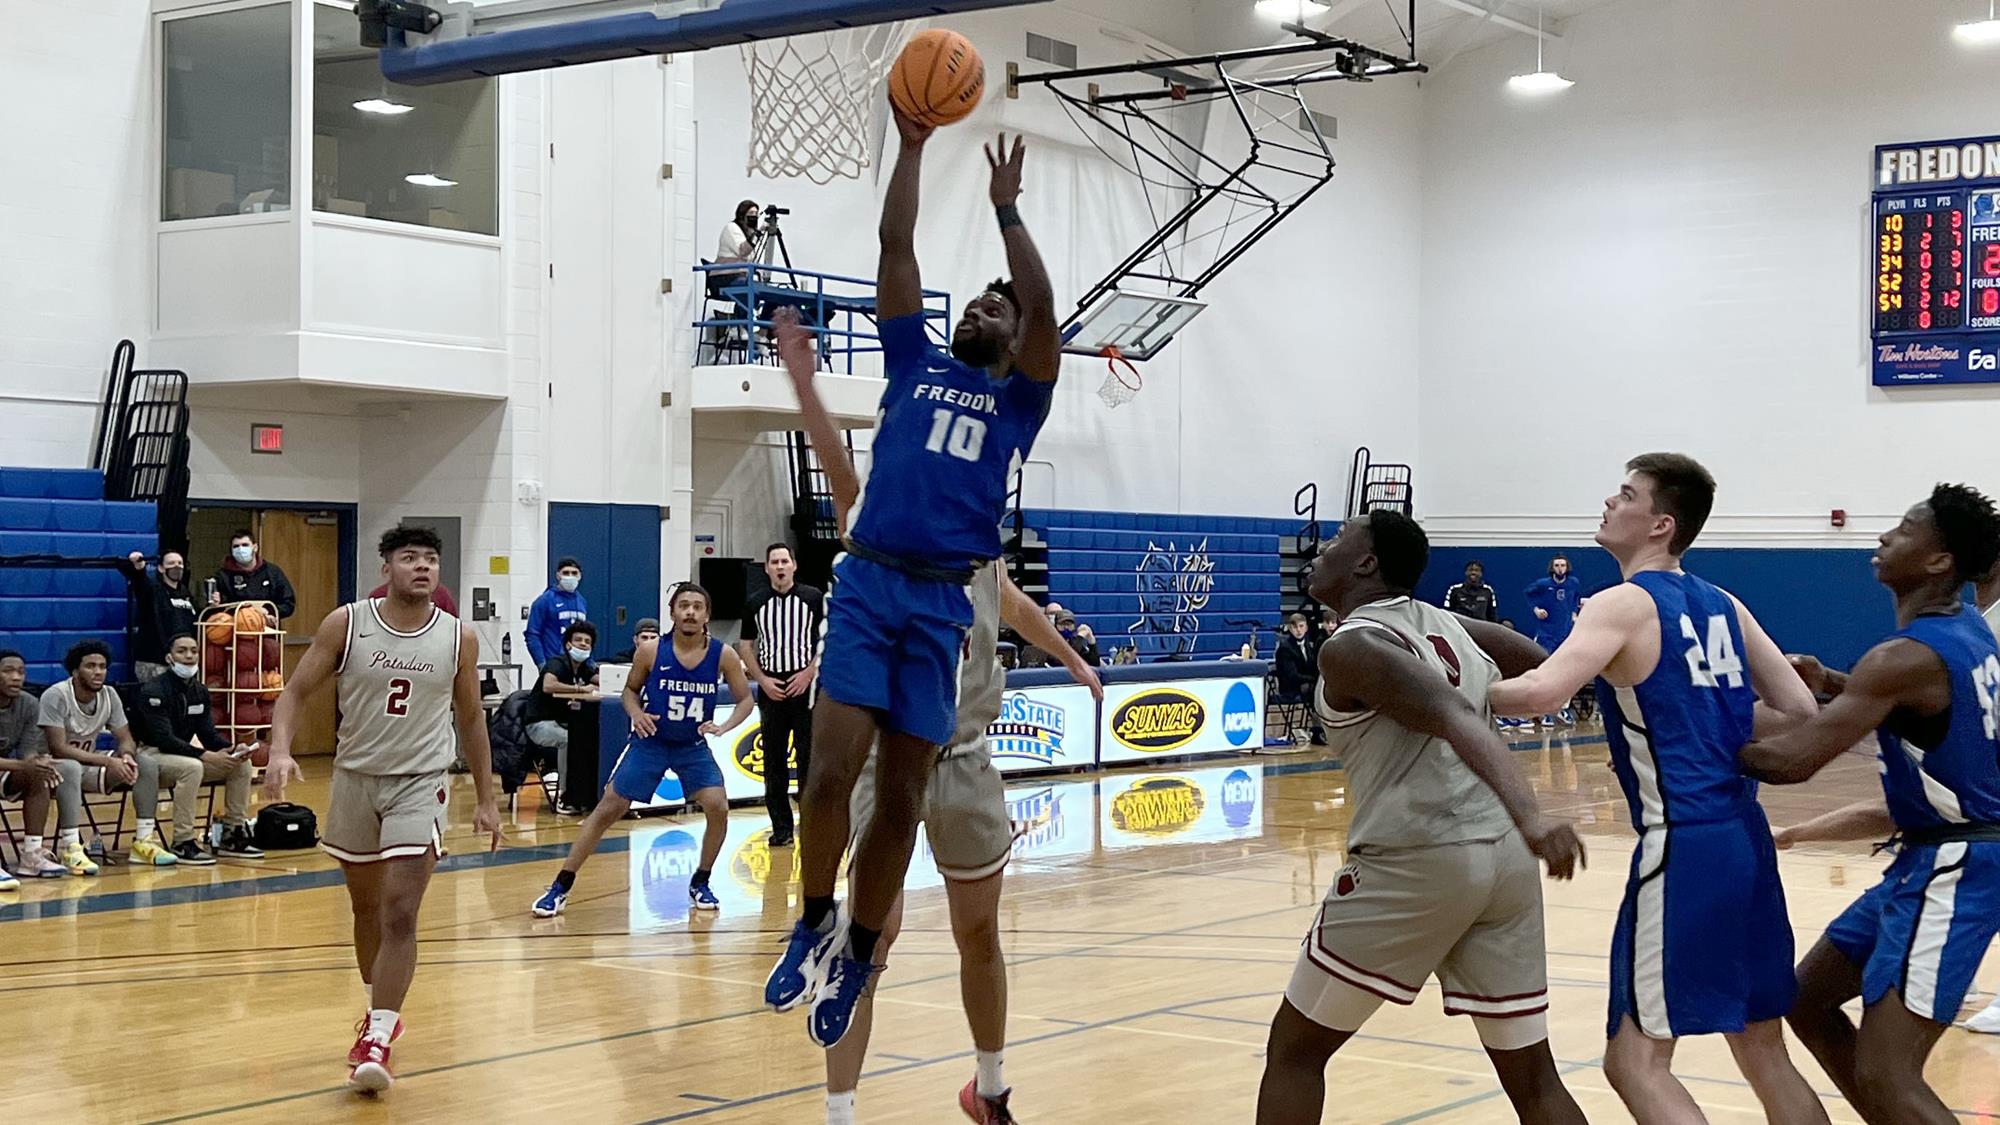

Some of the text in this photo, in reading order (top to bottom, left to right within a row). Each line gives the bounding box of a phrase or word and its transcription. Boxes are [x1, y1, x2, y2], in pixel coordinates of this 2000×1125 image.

[1880, 141, 2000, 185] FREDON
[1914, 198, 1927, 208] FLS
[1937, 196, 1952, 207] PTS
[1885, 210, 1962, 232] 10 1 3
[1881, 233, 1903, 252] 33
[1920, 232, 1932, 250] 2
[1972, 226, 2000, 242] FRE
[1880, 254, 1903, 272] 34
[1951, 250, 1962, 268] 3
[1879, 271, 1962, 292] 52 2 1
[1972, 278, 2000, 289] FOULS
[1879, 290, 1961, 312] 54 2 12
[1877, 343, 1959, 362] Tim Hortons
[925, 408, 988, 462] 10
[368, 649, 435, 673] Potsdam
[1679, 612, 1745, 690] 24
[385, 677, 413, 717] 2
[659, 679, 716, 694] FREDONIA
[667, 695, 705, 723] 54
[1013, 697, 1062, 731] STATE
[1121, 701, 1199, 734] SUNYAC
